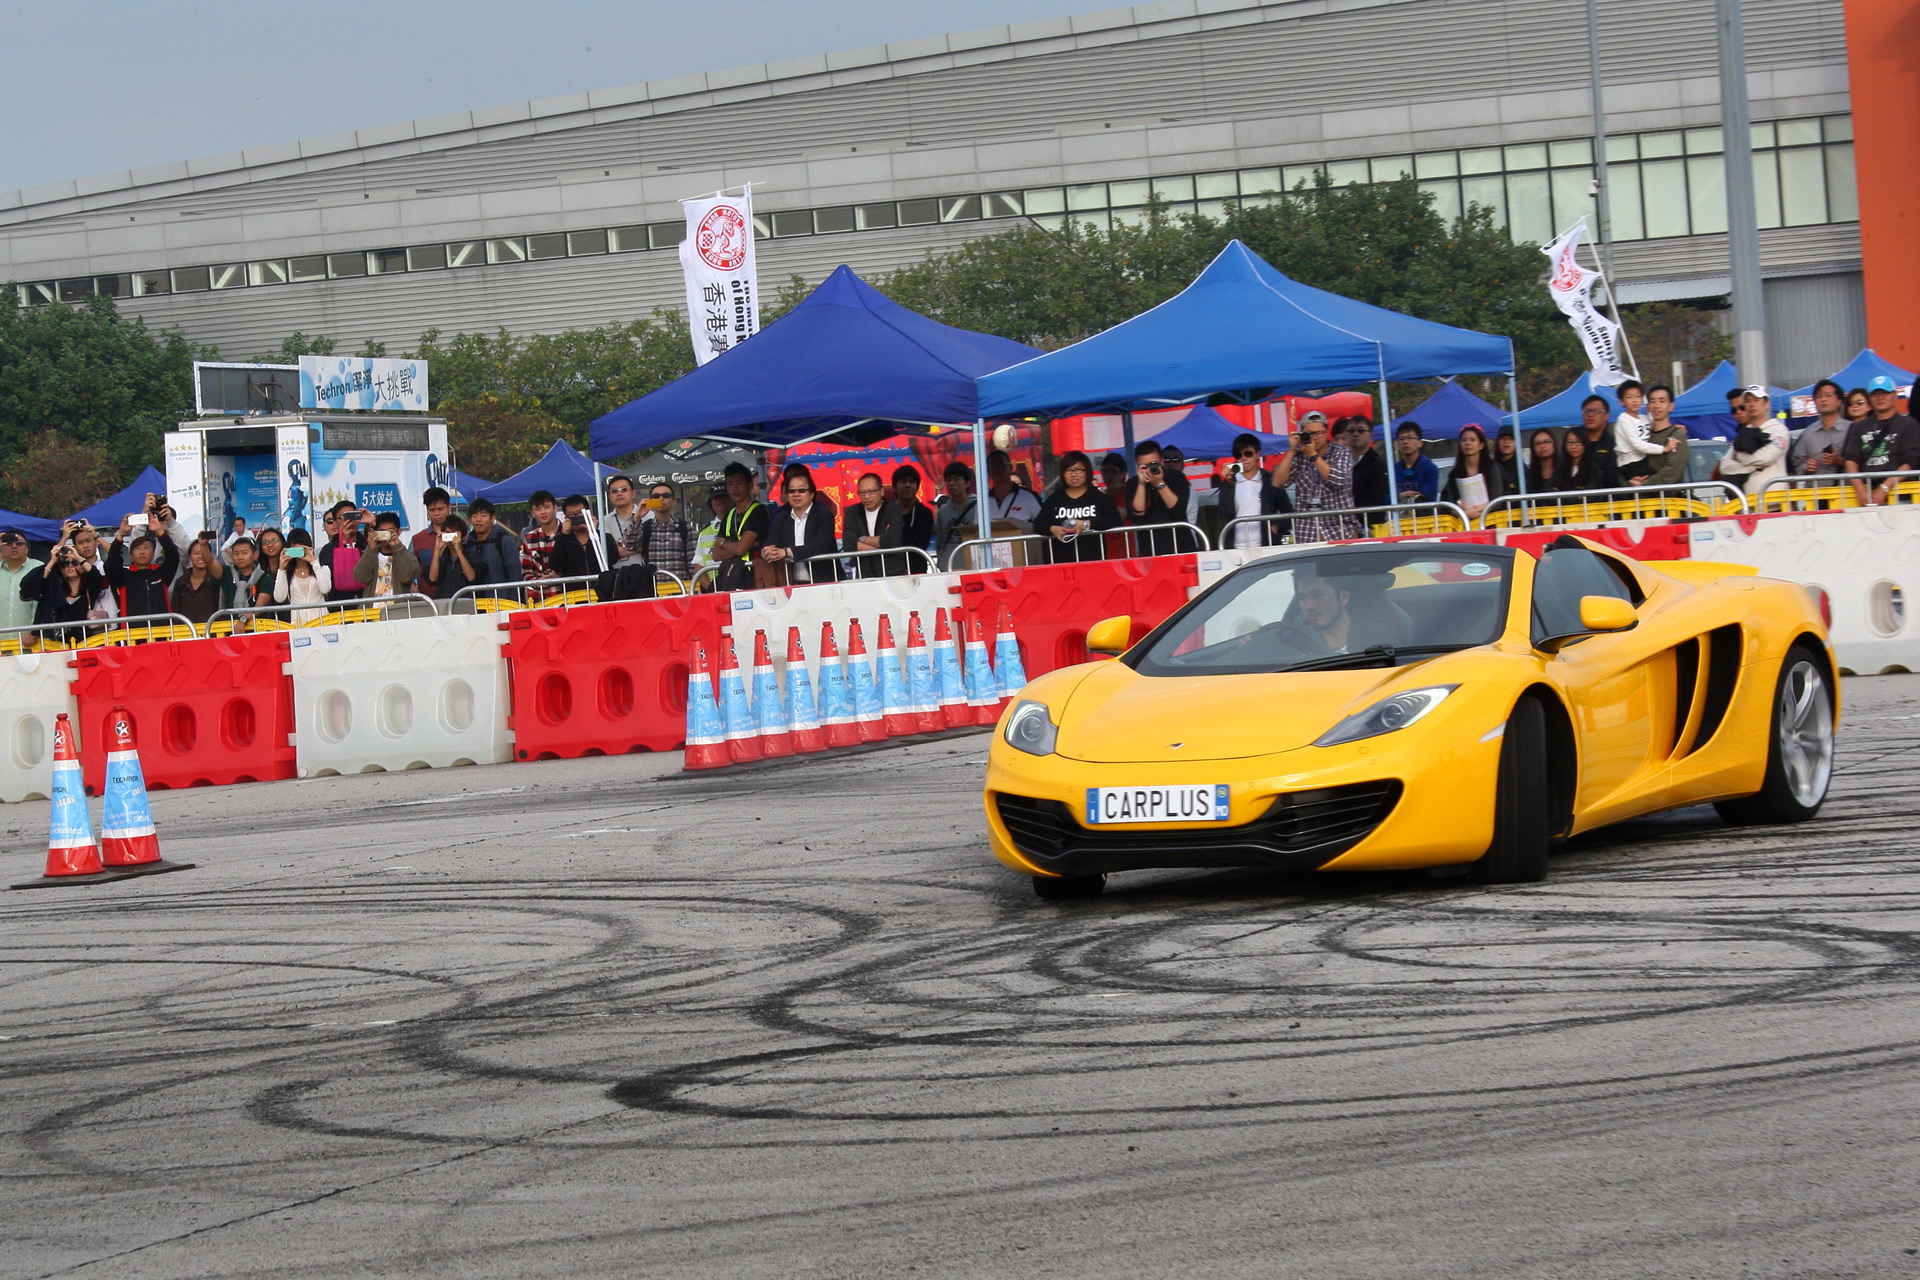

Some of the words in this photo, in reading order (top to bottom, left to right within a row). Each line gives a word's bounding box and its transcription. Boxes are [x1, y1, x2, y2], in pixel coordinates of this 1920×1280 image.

[731, 280, 743, 294] of
[733, 296, 746, 332] Hong
[315, 380, 351, 401] Techron
[639, 475, 666, 486] Carlsberg
[672, 472, 699, 484] Carlsberg
[705, 470, 726, 482] Carlsb
[362, 490, 394, 507] 5大效益
[1104, 789, 1209, 819] CARPLUS
